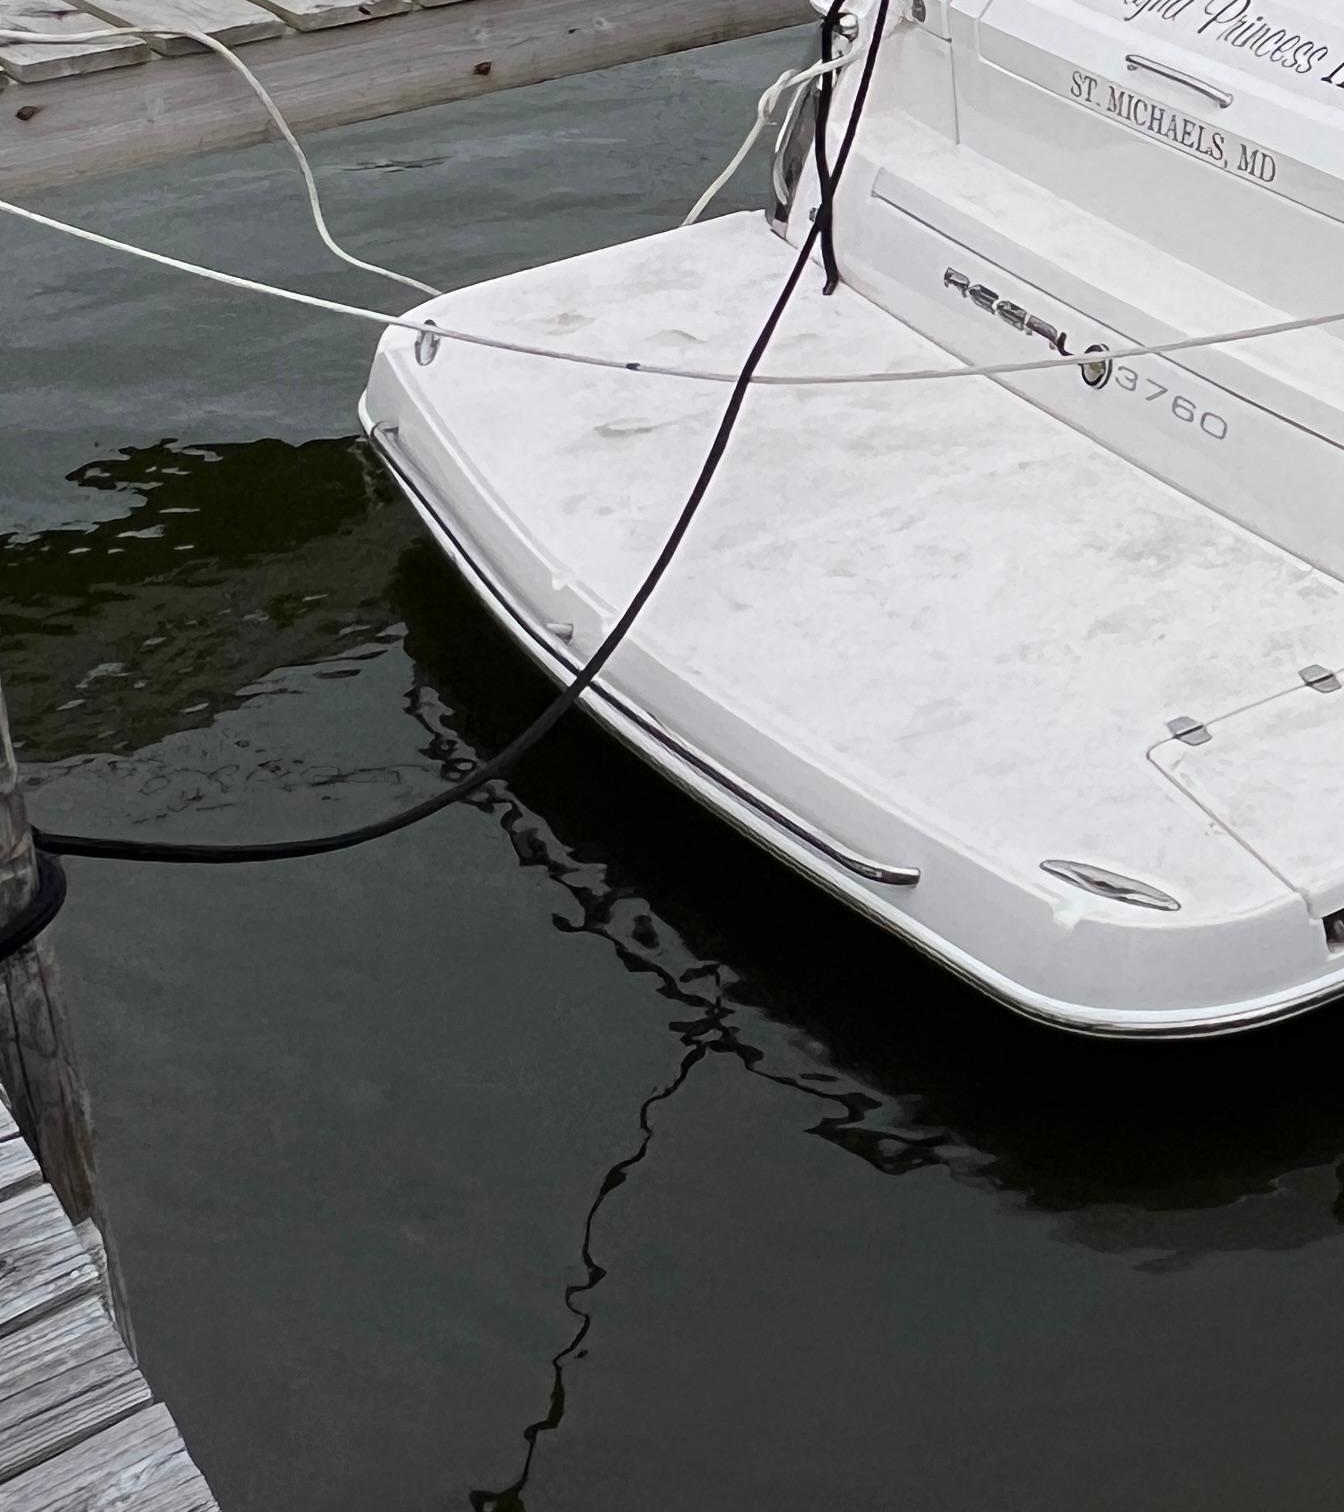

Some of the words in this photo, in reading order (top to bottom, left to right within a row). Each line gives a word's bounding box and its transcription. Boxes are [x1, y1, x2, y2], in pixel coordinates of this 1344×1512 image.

[1070, 70, 1102, 108] ST.
[1106, 85, 1229, 170] MICHAELS,
[1237, 143, 1277, 184] MD
[943, 266, 1077, 357] REGAL
[1115, 365, 1229, 440] 3760
